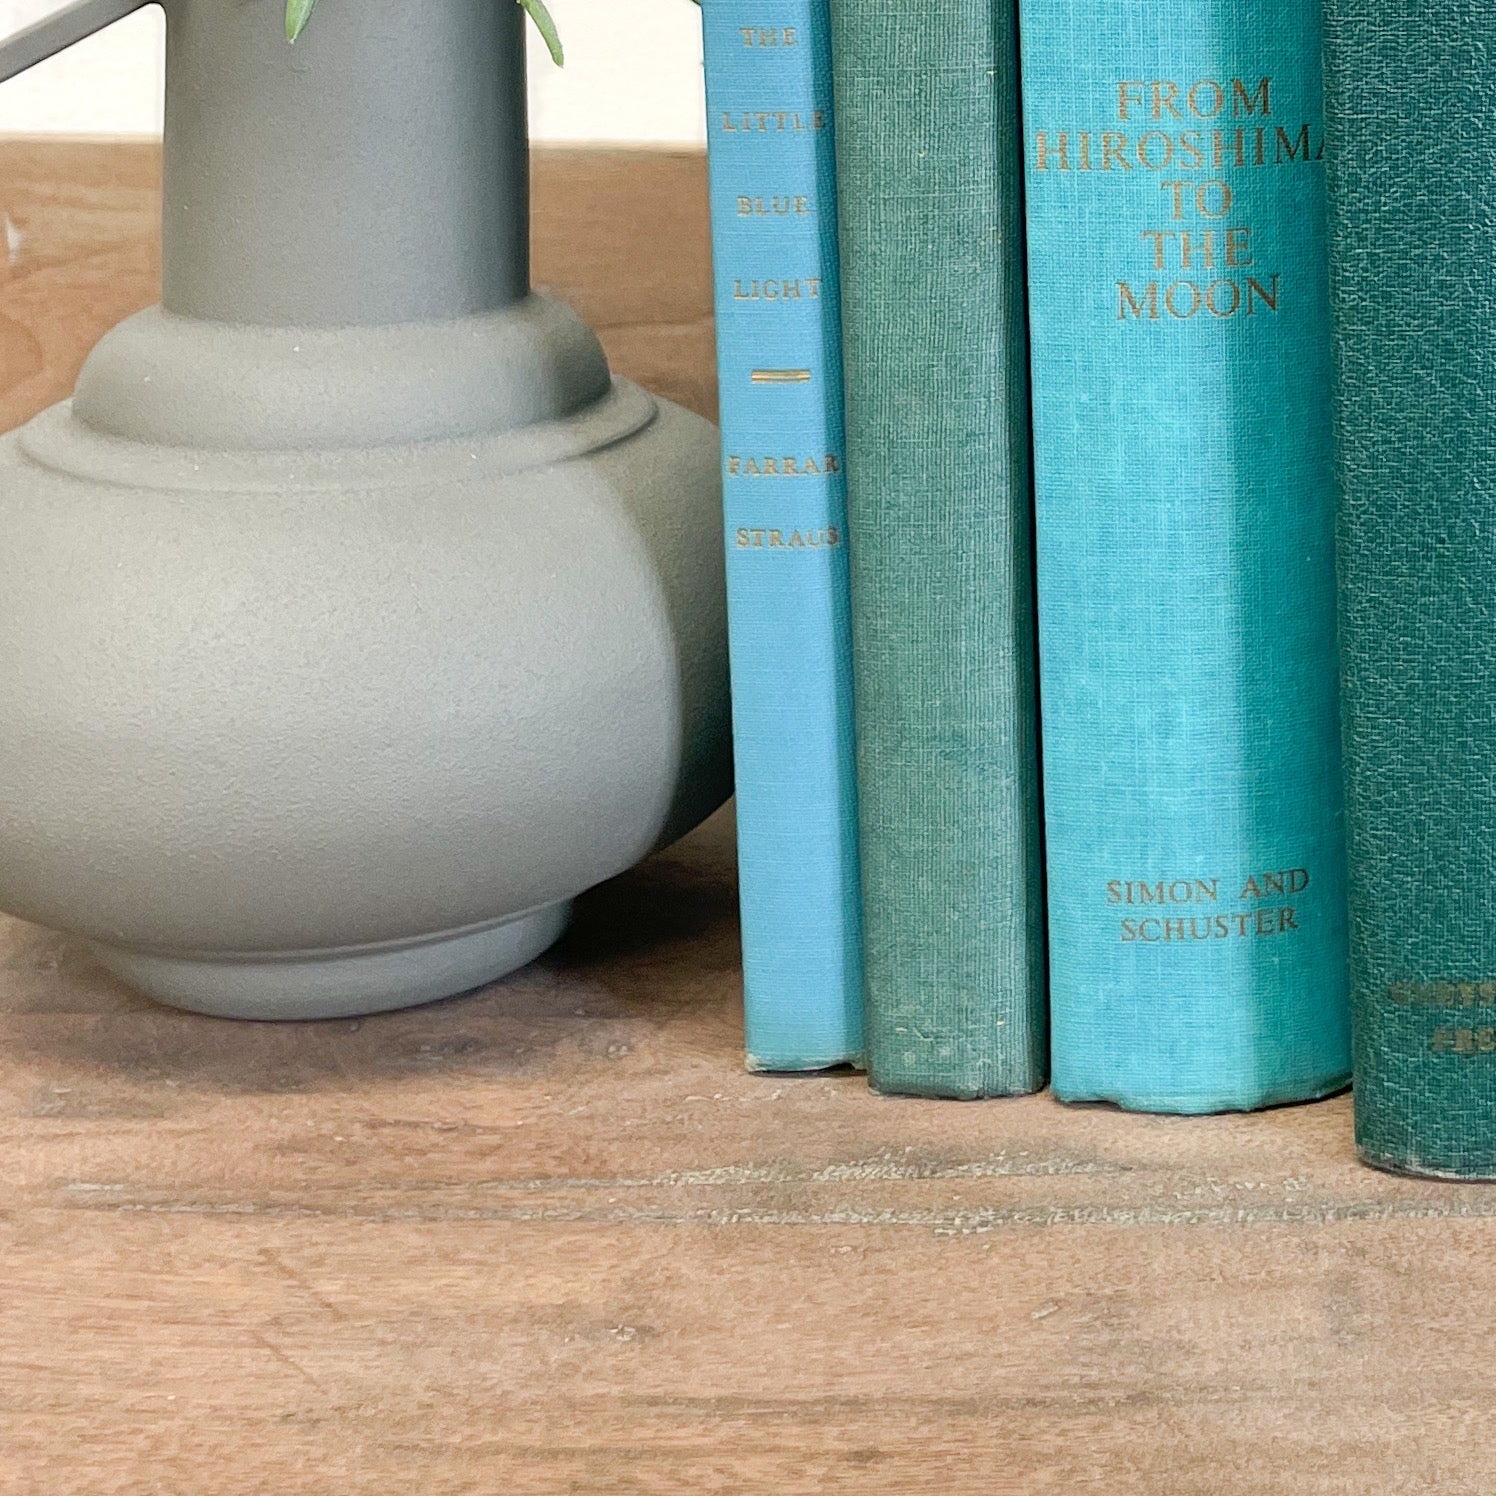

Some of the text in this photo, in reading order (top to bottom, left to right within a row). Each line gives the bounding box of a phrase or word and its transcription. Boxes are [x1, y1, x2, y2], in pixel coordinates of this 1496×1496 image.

[738, 27, 798, 48] THE
[1117, 76, 1272, 121] FROM
[721, 112, 826, 133] LITTLE
[1034, 124, 1326, 171] HIROSHIM
[737, 196, 810, 217] BLUE
[1160, 180, 1234, 220] TO
[1140, 227, 1253, 271] THE
[733, 278, 823, 300] LIGHT
[1116, 272, 1281, 320] MOON
[728, 456, 840, 478] FARRAR
[736, 528, 841, 549] STRAUS
[1106, 868, 1310, 906] SIMON AND
[1120, 907, 1300, 942] SCHUSTER
